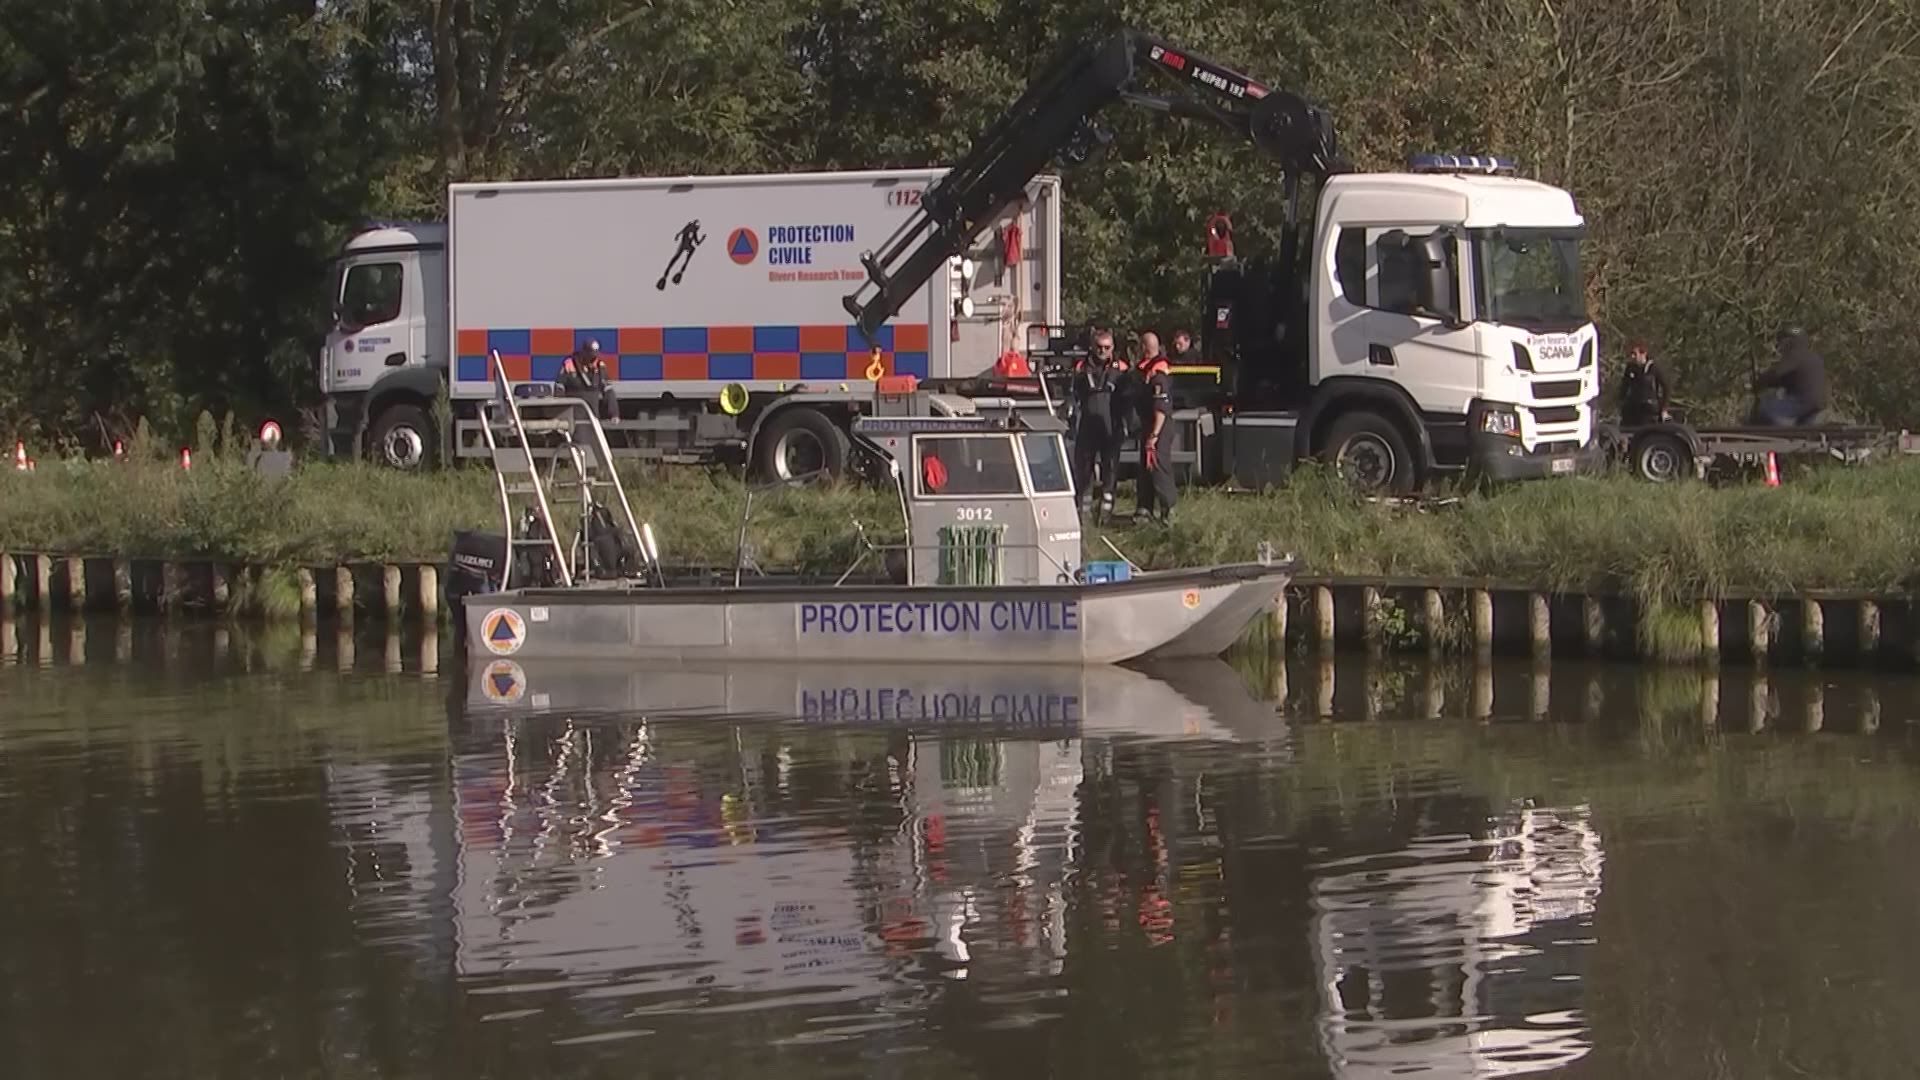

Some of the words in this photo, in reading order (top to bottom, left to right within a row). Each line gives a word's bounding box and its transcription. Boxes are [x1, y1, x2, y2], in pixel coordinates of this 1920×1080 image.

[896, 189, 921, 205] 112
[768, 224, 855, 243] PROTECTION
[768, 247, 812, 264] CIVILE
[769, 271, 796, 282] Divers
[798, 270, 839, 281] Research
[841, 269, 864, 280] Team
[1539, 345, 1574, 360] SCANIA
[957, 507, 993, 521] 3012
[802, 602, 981, 633] PROTECTION
[990, 601, 1079, 630] CIVILE
